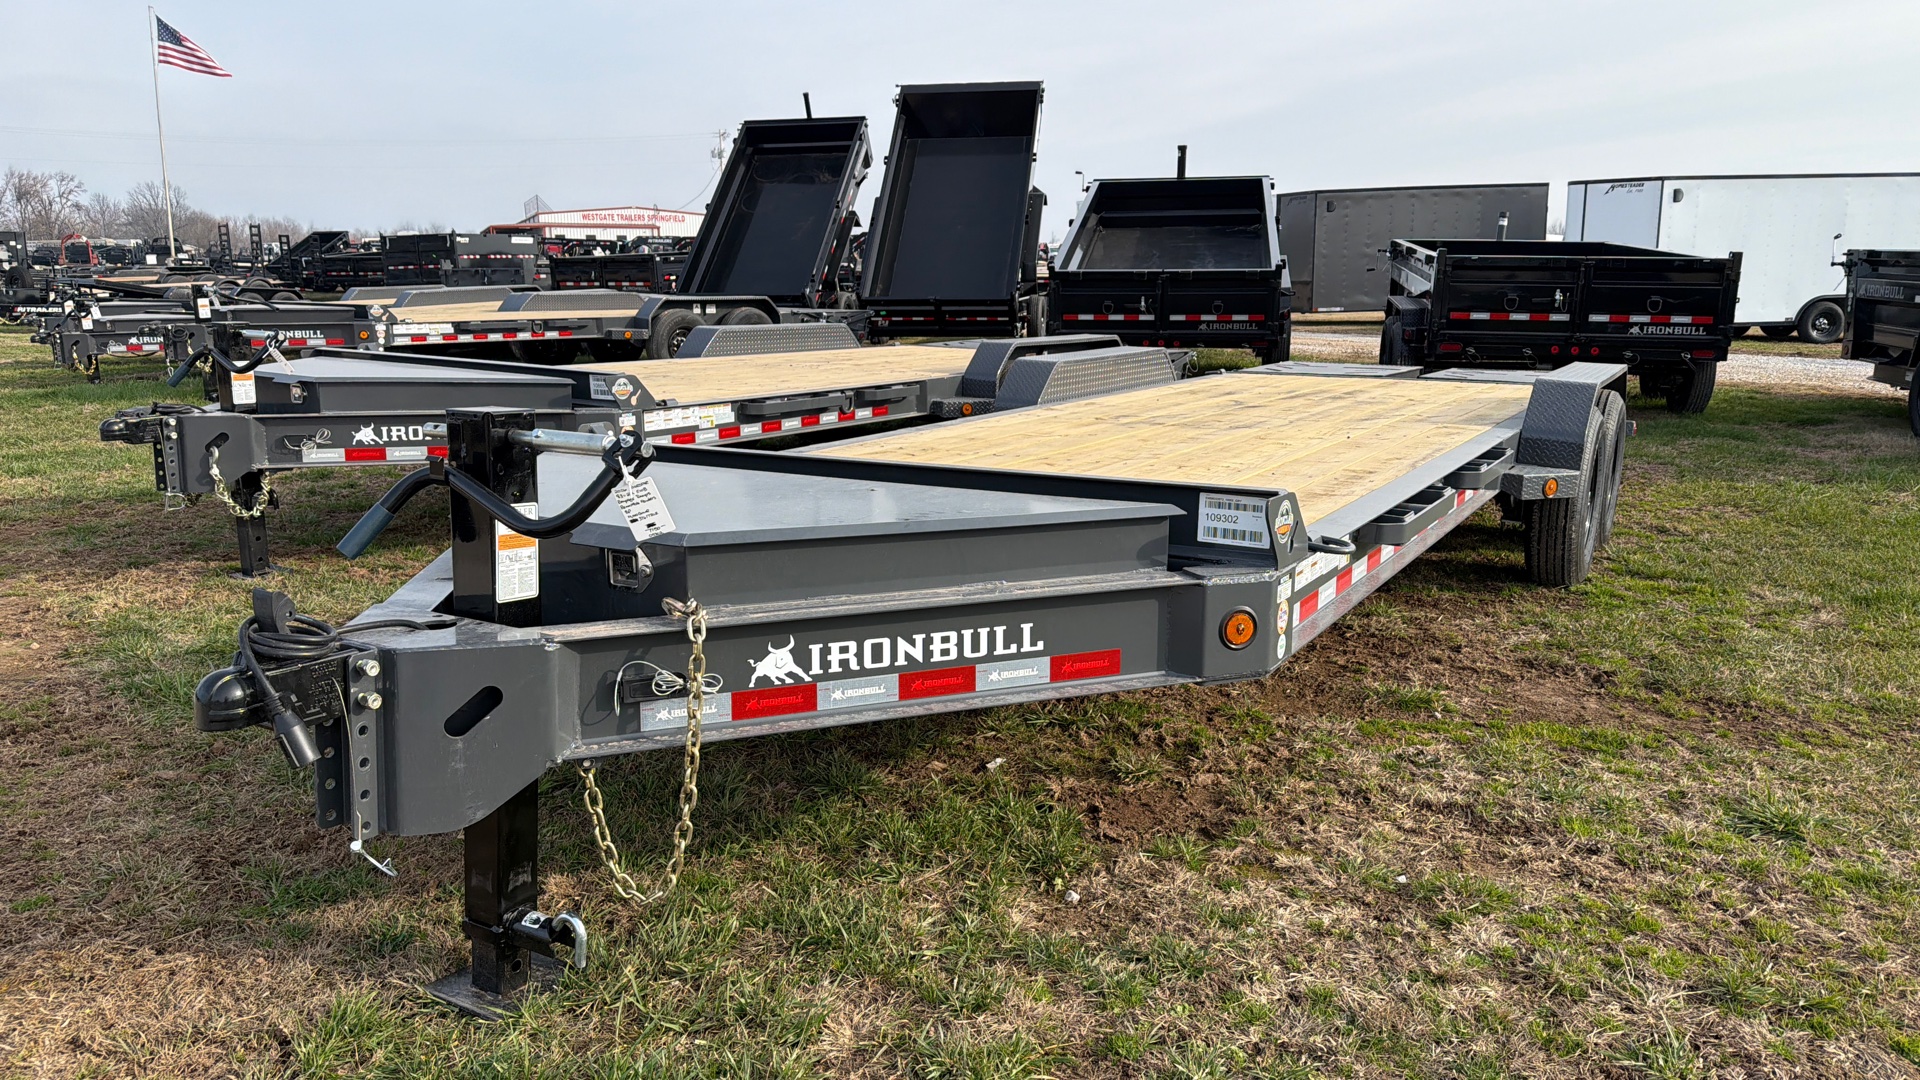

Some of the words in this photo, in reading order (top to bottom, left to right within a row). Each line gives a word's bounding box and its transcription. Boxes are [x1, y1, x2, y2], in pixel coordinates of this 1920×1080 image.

[582, 213, 615, 221] WESTGATE
[616, 214, 646, 222] TRAILERS
[647, 214, 685, 223] SPRINGFIELD
[1866, 284, 1904, 299] IRONBULL
[1209, 322, 1258, 330] IRONBULL
[1643, 325, 1707, 335] IRONBULL
[1205, 513, 1239, 524] 109302
[808, 622, 1044, 675] IRONBULL
[1073, 657, 1110, 671] IRONBULL
[1001, 665, 1039, 679] IRONBULL
[924, 674, 964, 687] IRONBULL
[844, 683, 886, 697] IRONBULL
